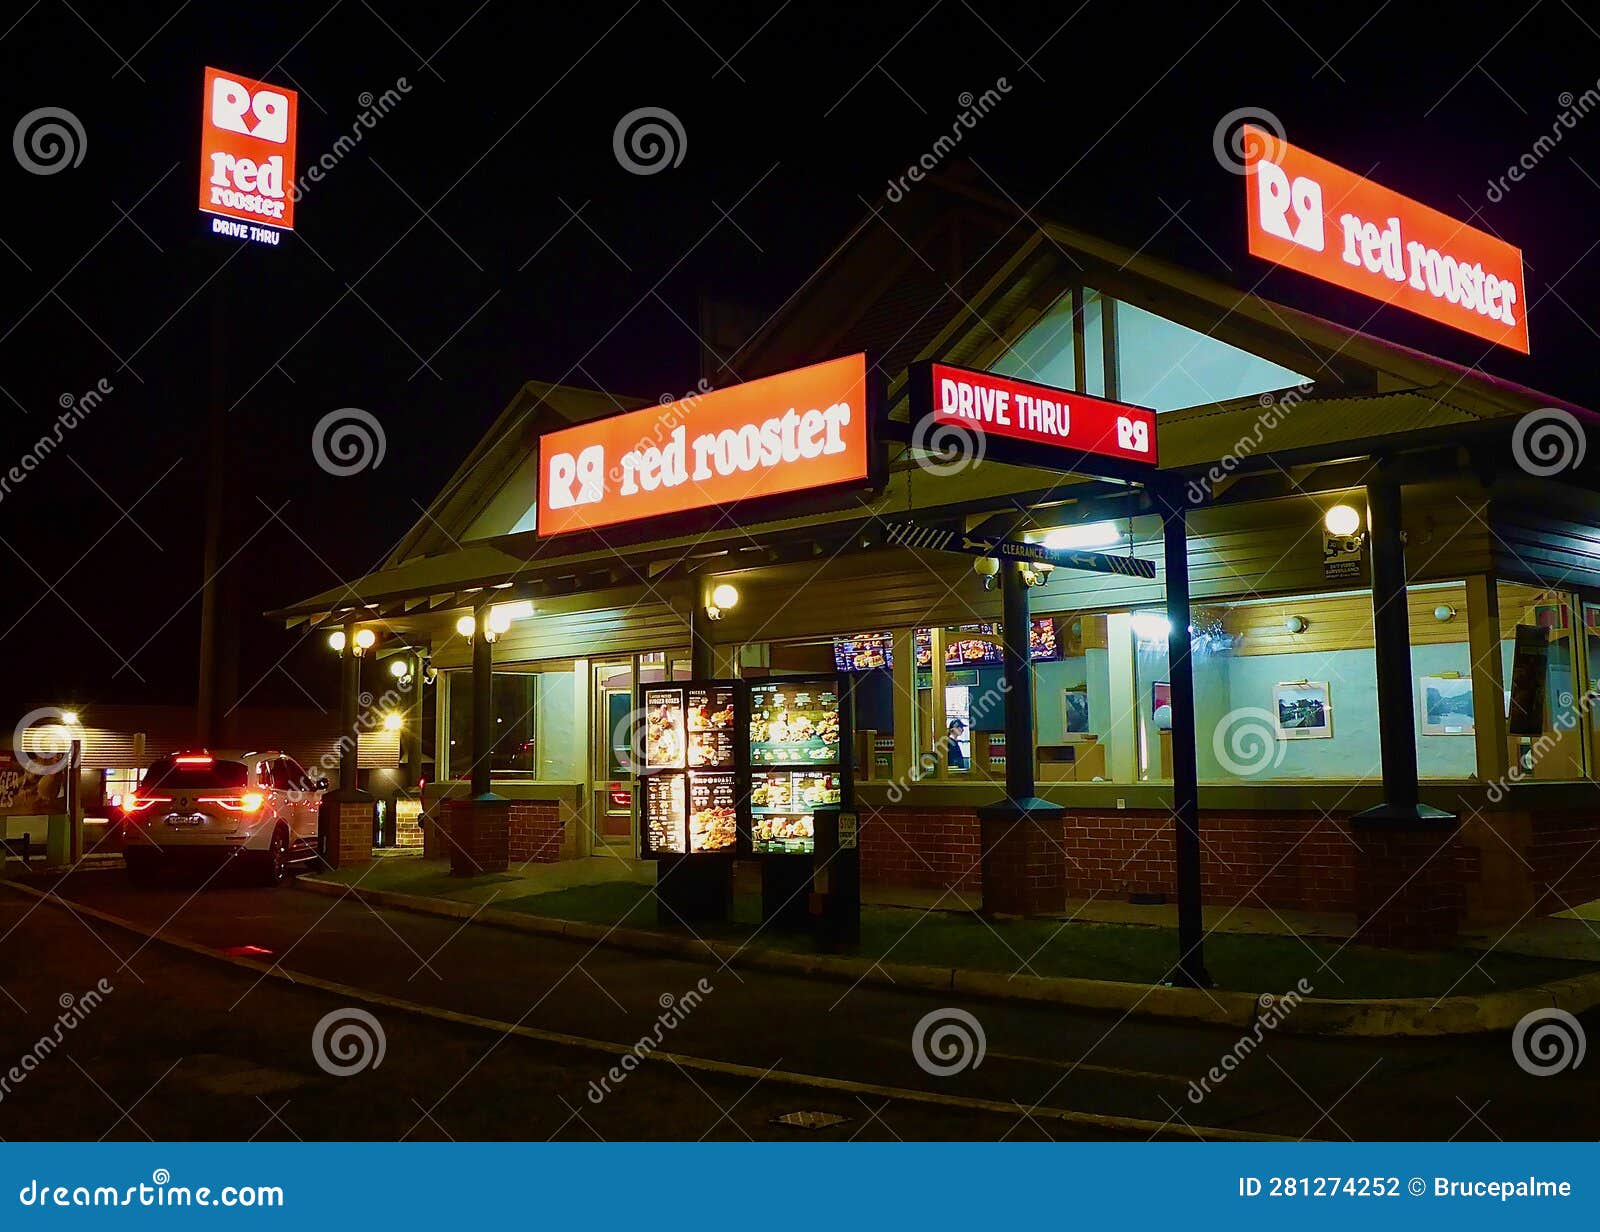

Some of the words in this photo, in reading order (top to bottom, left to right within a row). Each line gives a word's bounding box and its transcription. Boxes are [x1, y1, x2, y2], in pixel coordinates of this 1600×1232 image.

[210, 152, 285, 199] red
[210, 187, 285, 219] rooster
[213, 219, 248, 239] DRIVE
[250, 226, 280, 246] THRU
[1340, 213, 1406, 281] red
[1407, 240, 1516, 326] rooster
[941, 379, 1011, 426] DRIVE
[1014, 393, 1070, 437] THRU
[620, 425, 688, 495] red
[692, 402, 850, 482] rooster
[1002, 544, 1043, 559] CLEARANCE
